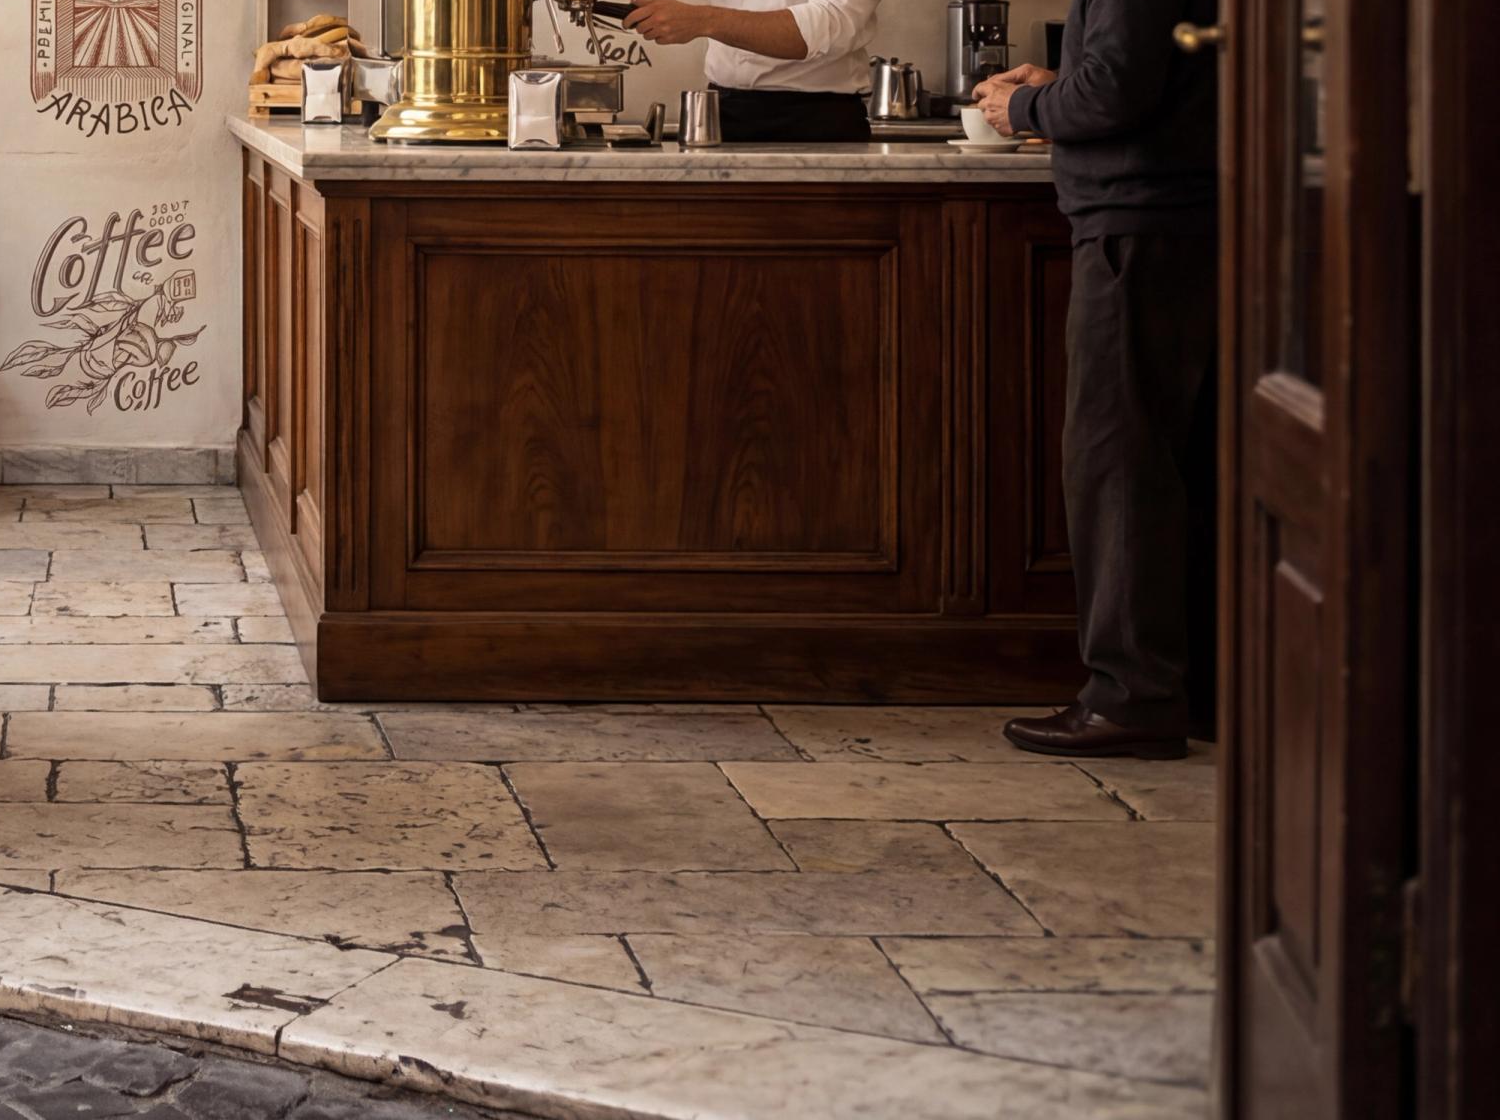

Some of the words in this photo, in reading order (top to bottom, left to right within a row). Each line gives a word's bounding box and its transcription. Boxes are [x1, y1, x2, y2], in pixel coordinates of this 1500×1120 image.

[36, 87, 193, 138] ARABICA
[30, 208, 197, 318] Coffee
[113, 360, 200, 412] Coffee
